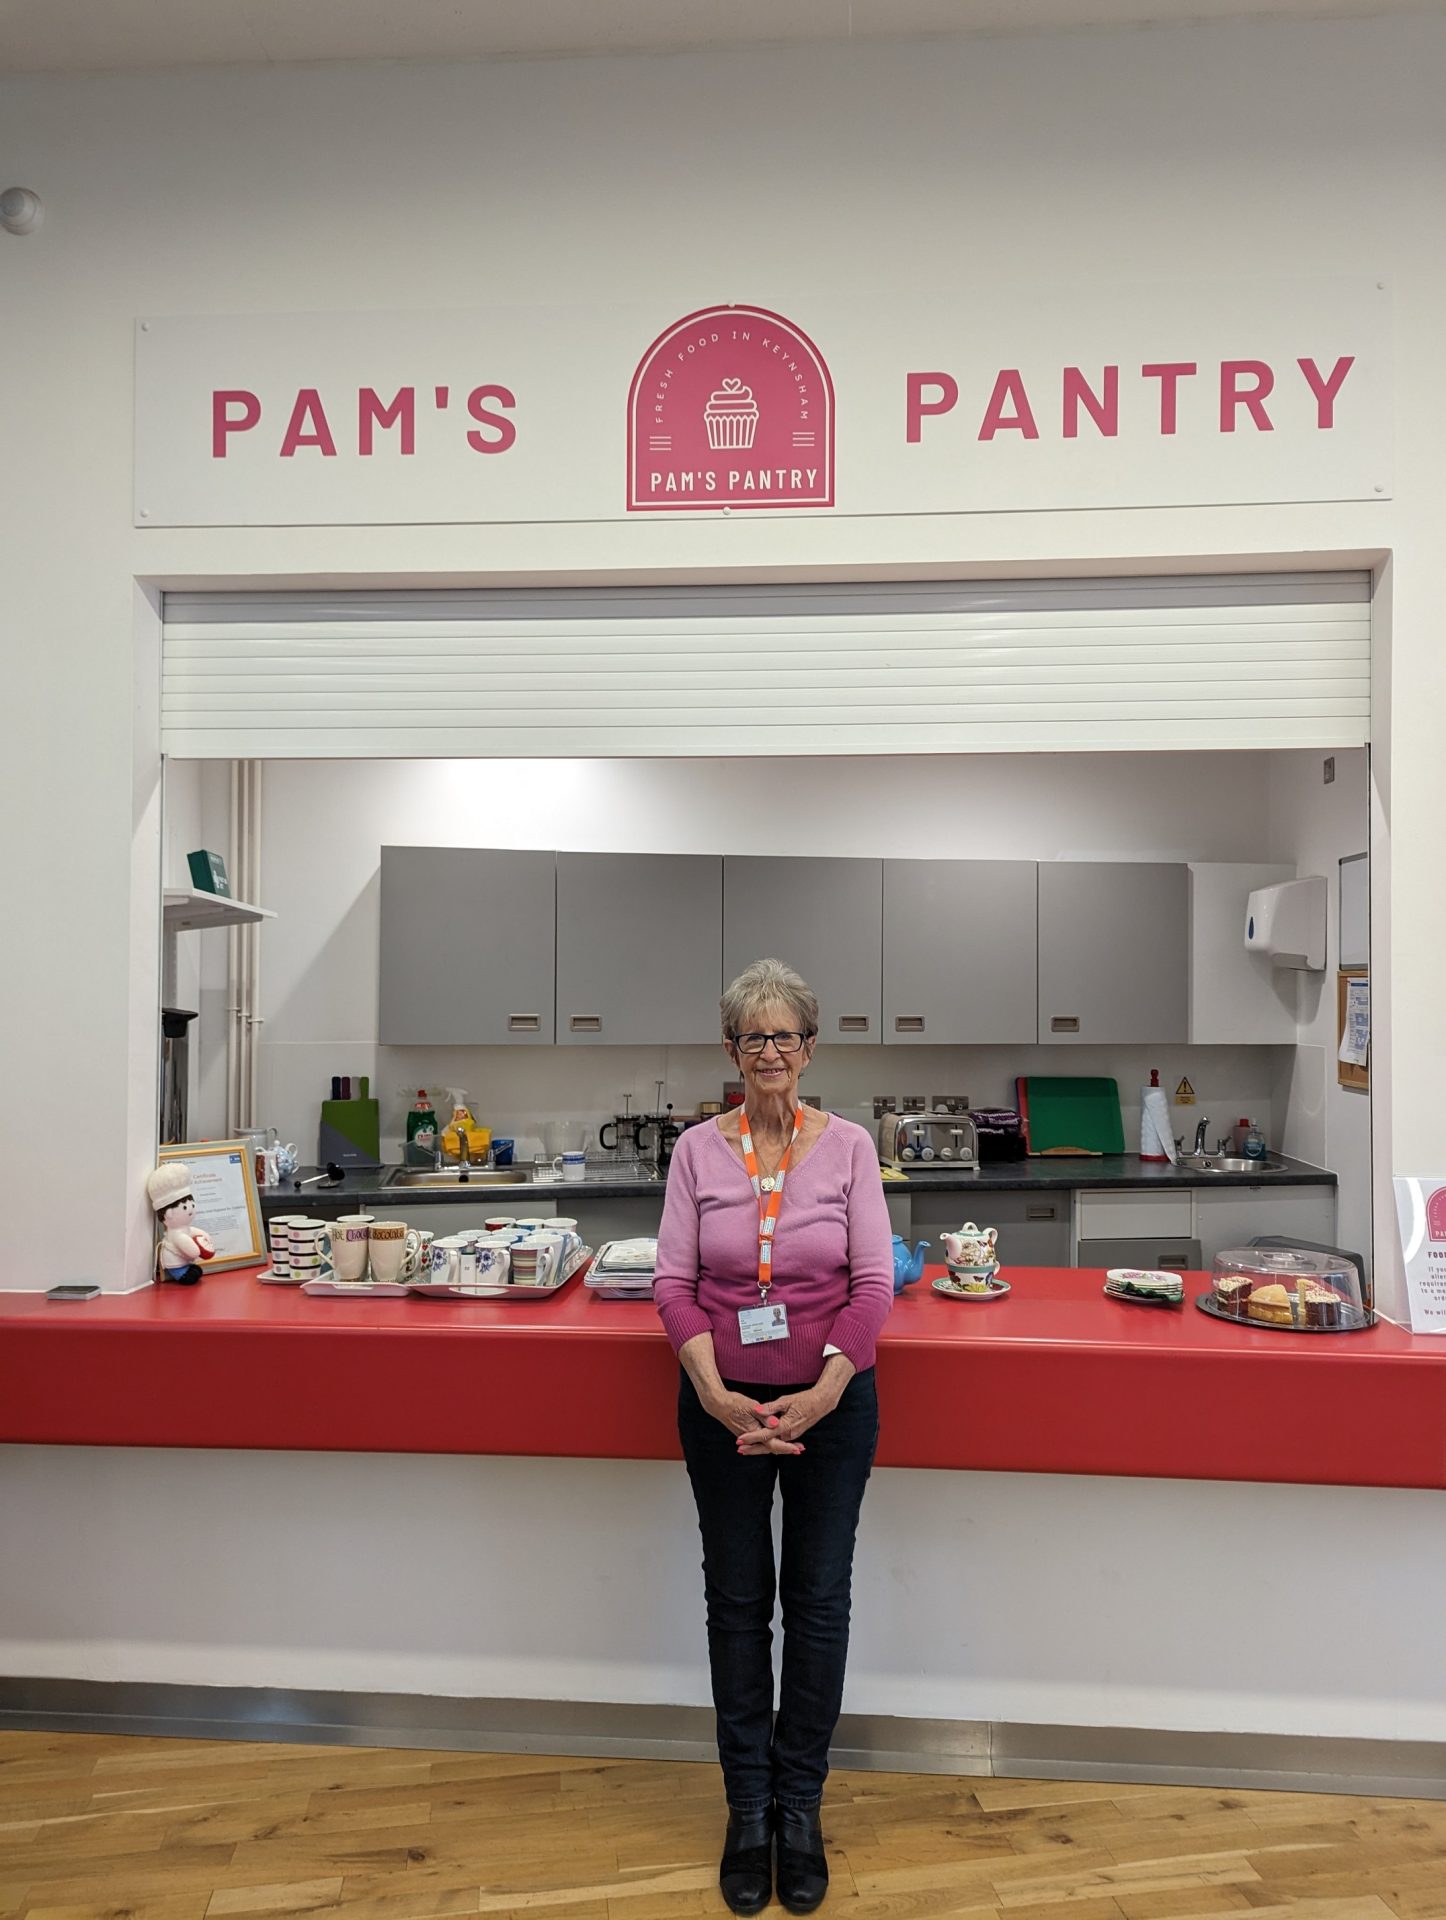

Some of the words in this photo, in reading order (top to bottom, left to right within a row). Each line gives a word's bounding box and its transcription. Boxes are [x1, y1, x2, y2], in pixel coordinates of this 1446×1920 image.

[212, 384, 517, 458] PAM'S
[906, 356, 1355, 443] PANTRY
[655, 369, 674, 424] FRESH
[678, 333, 719, 361] FOOD
[732, 331, 750, 341] IN
[762, 338, 808, 420] KEYNSHAM
[650, 471, 717, 492] PAM'S
[729, 469, 818, 490] PANTRY
